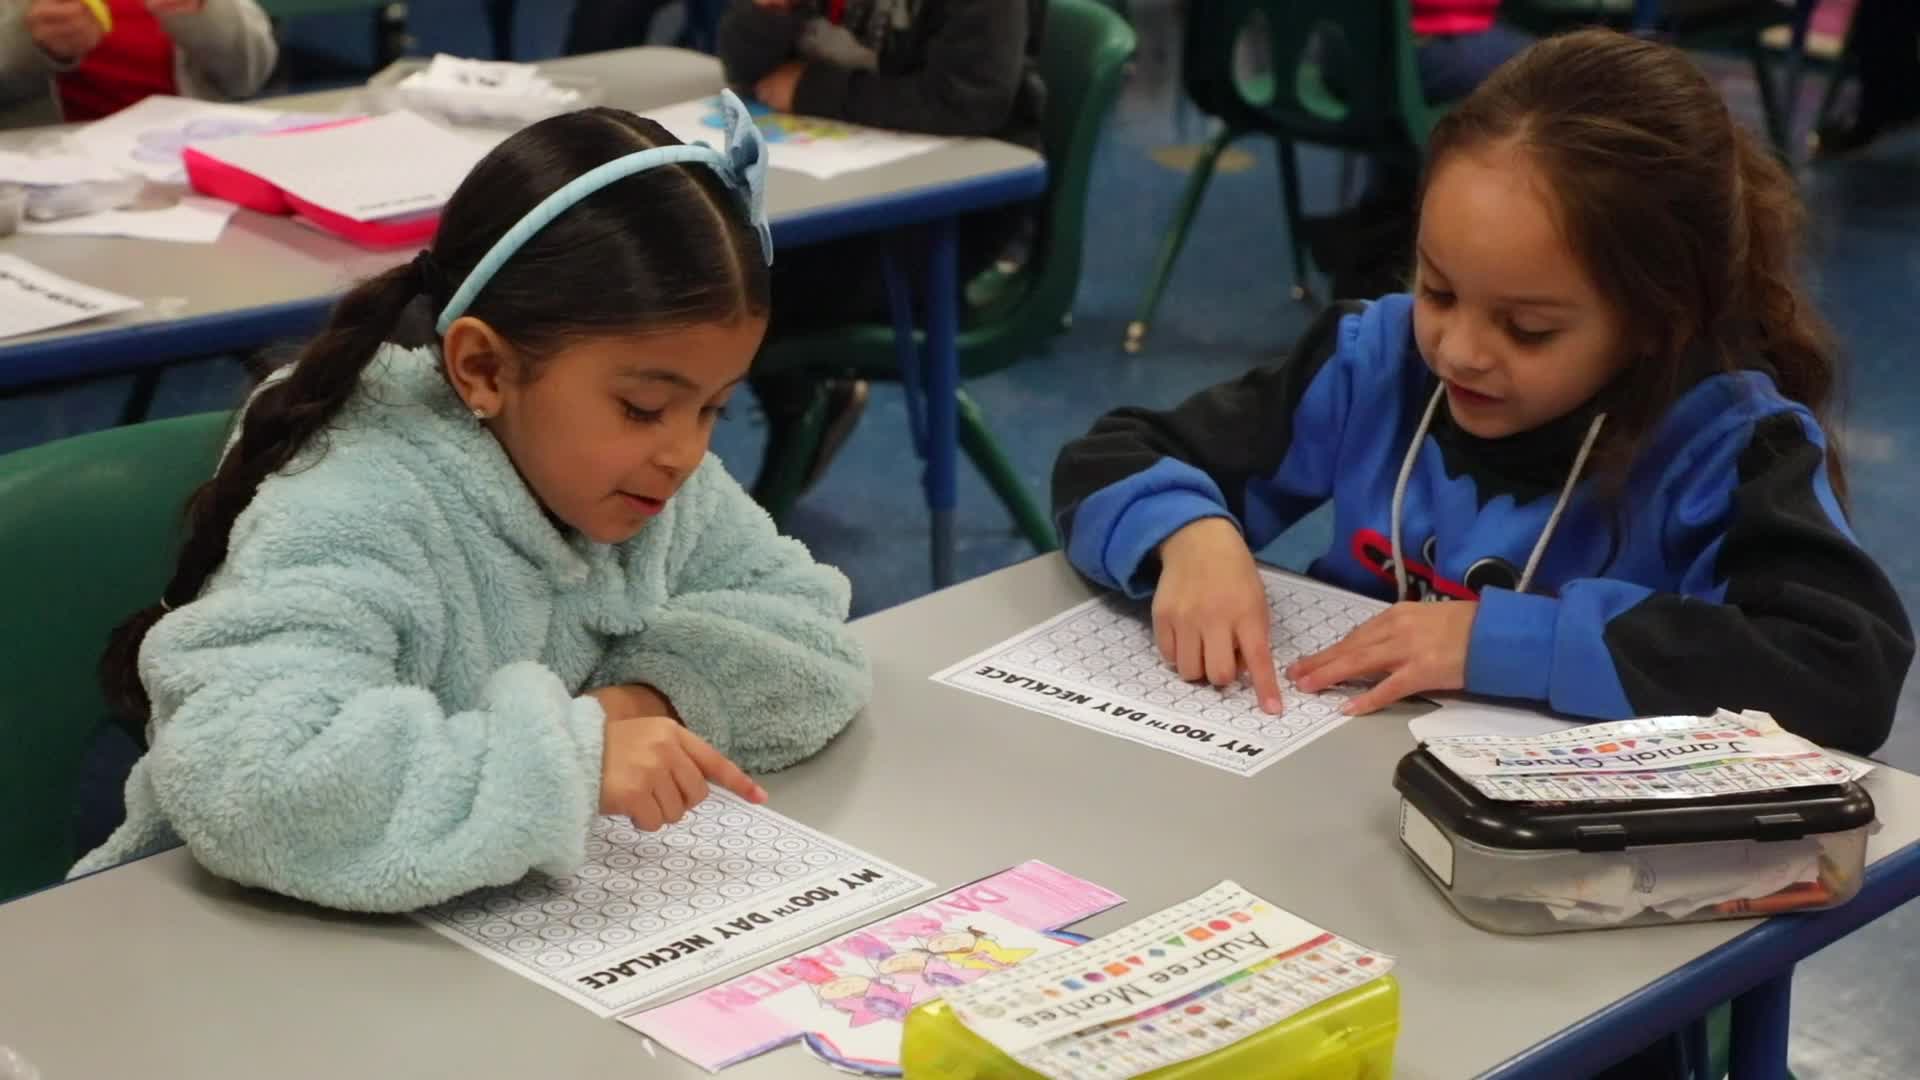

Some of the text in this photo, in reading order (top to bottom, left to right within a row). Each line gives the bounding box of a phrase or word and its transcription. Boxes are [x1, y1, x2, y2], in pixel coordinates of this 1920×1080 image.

[975, 665, 1092, 705] NECKLACE
[1092, 701, 1148, 723] DAY
[1217, 739, 1264, 757] MY
[838, 868, 883, 890] MY
[712, 911, 773, 940] DAY
[577, 933, 714, 990] NECKLACE
[1015, 930, 1270, 1028] Aubree Montes
